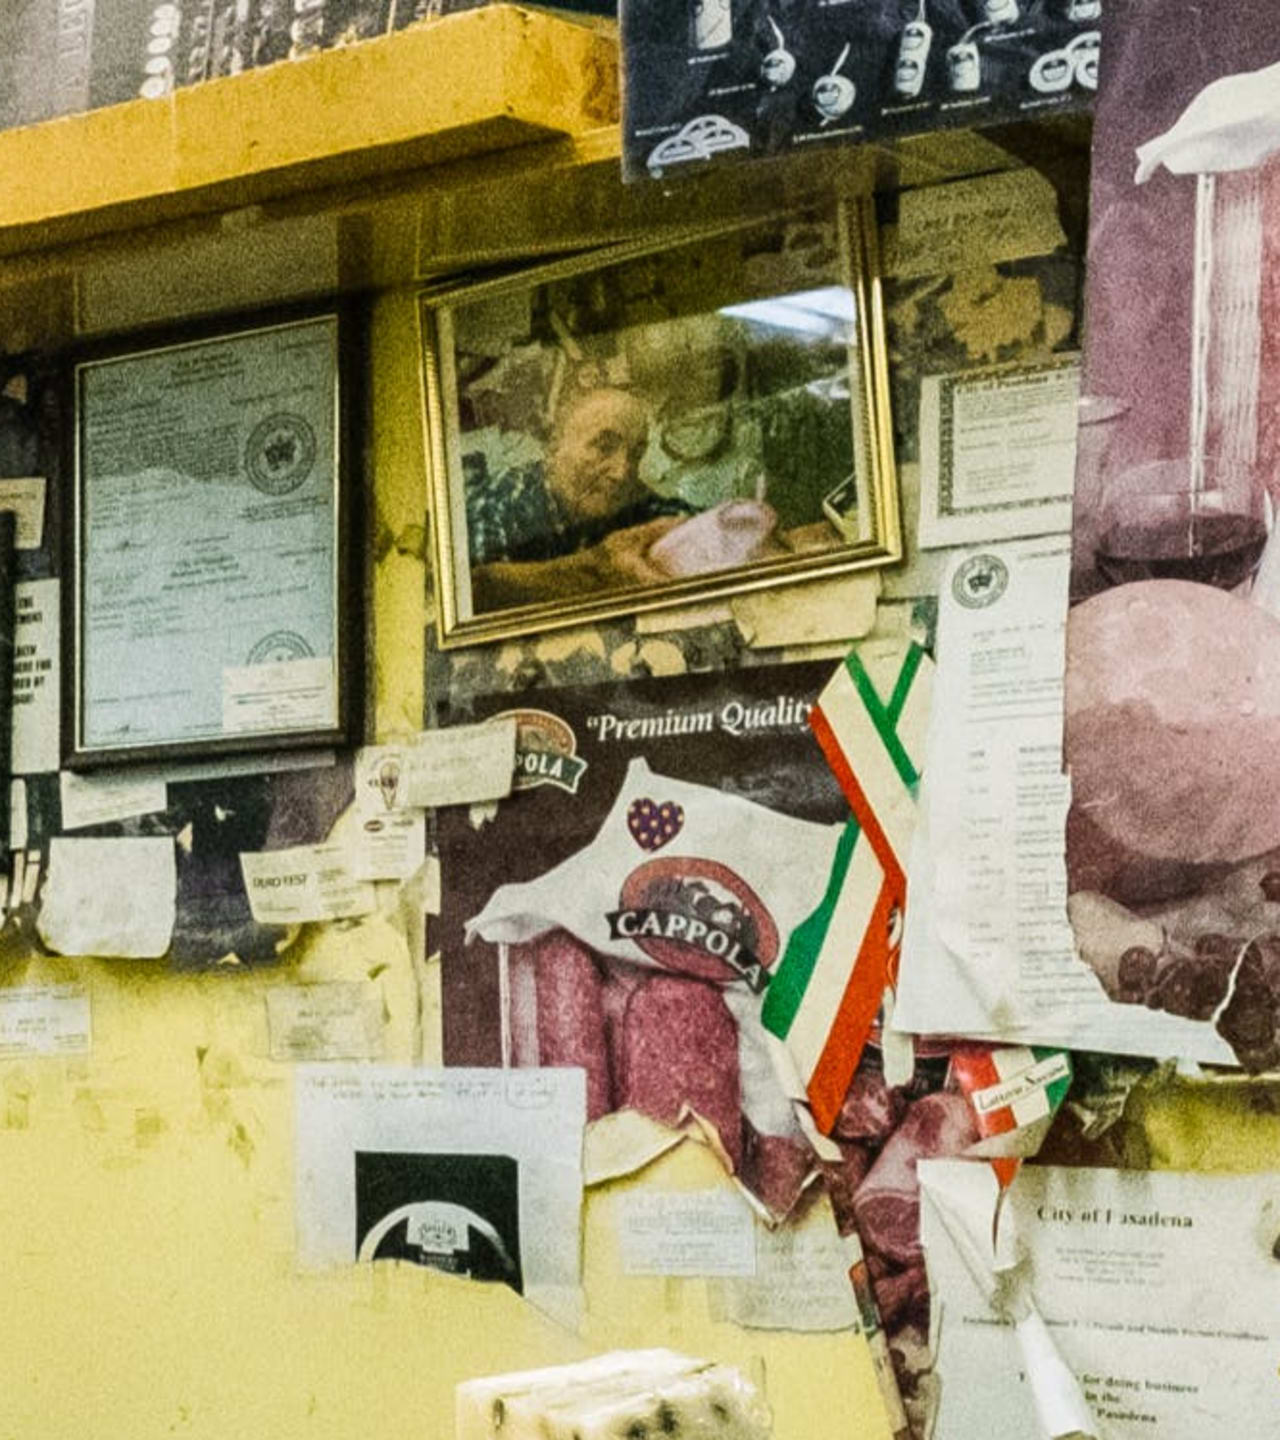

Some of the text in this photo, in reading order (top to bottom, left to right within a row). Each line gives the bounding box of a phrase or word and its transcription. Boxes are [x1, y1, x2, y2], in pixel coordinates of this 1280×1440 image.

[616, 911, 762, 988] CAPPOLA
[1037, 1206, 1193, 1228] City of Pasadena
[1097, 1407, 1158, 1424] Pasadena
